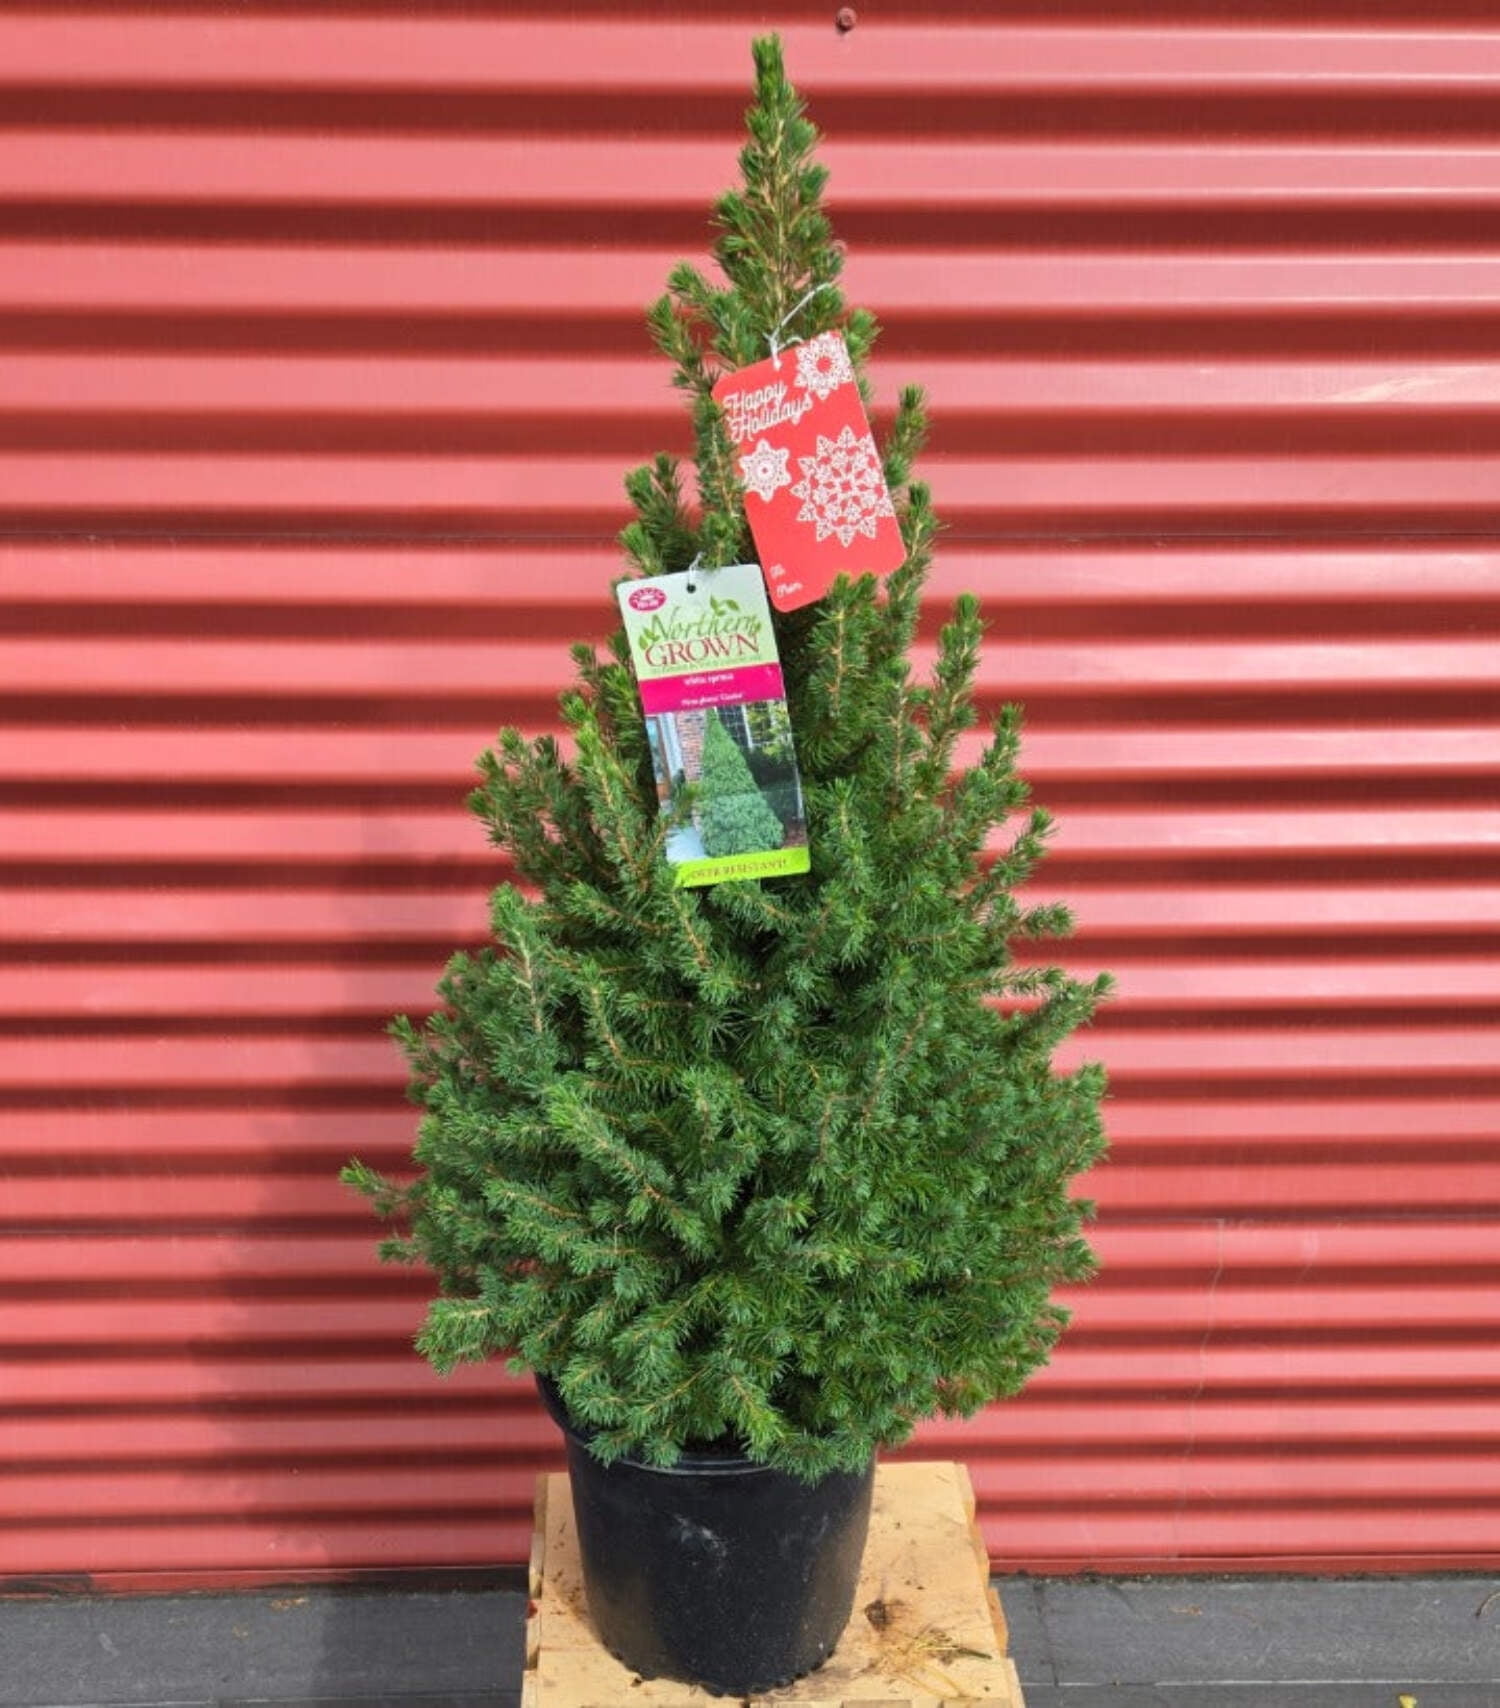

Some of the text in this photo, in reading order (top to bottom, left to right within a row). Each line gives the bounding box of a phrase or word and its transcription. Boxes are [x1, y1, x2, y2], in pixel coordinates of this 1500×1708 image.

[722, 381, 788, 417] Happy
[726, 392, 813, 443] Holidays
[651, 606, 758, 640] Northern
[644, 632, 761, 667] GROWN
